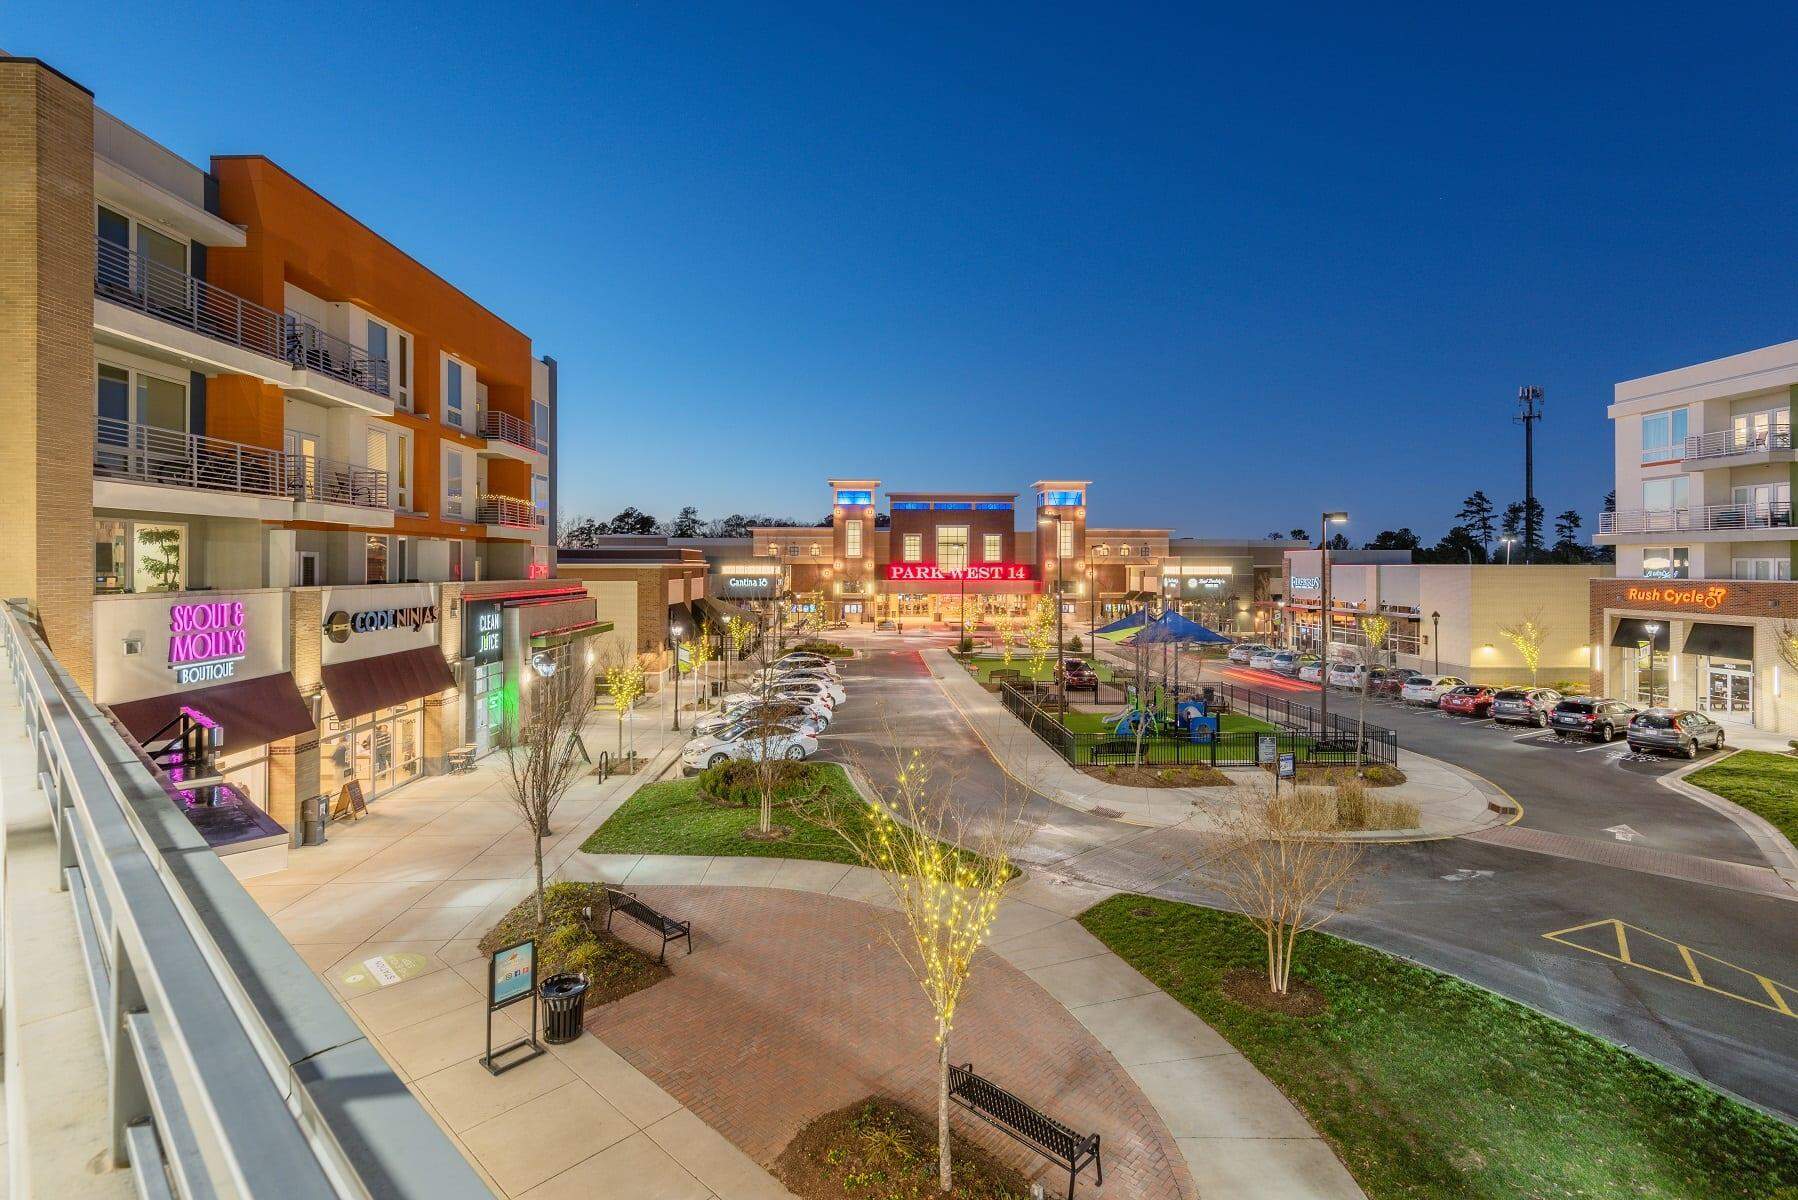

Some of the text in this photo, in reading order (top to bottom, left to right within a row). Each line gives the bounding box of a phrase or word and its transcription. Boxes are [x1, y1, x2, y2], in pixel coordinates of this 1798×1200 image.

[729, 577, 757, 587] Cantina
[891, 566, 1025, 579] PARK WEST 14
[1629, 588, 1704, 604] Rush Cycle
[171, 602, 245, 632] SCOUT &
[353, 606, 439, 633] CODE NINJAS
[479, 613, 500, 631] CLEAN
[170, 629, 245, 663] MOLLY'S
[479, 631, 499, 653] JUICE
[181, 662, 234, 684] BOUTIQUE
